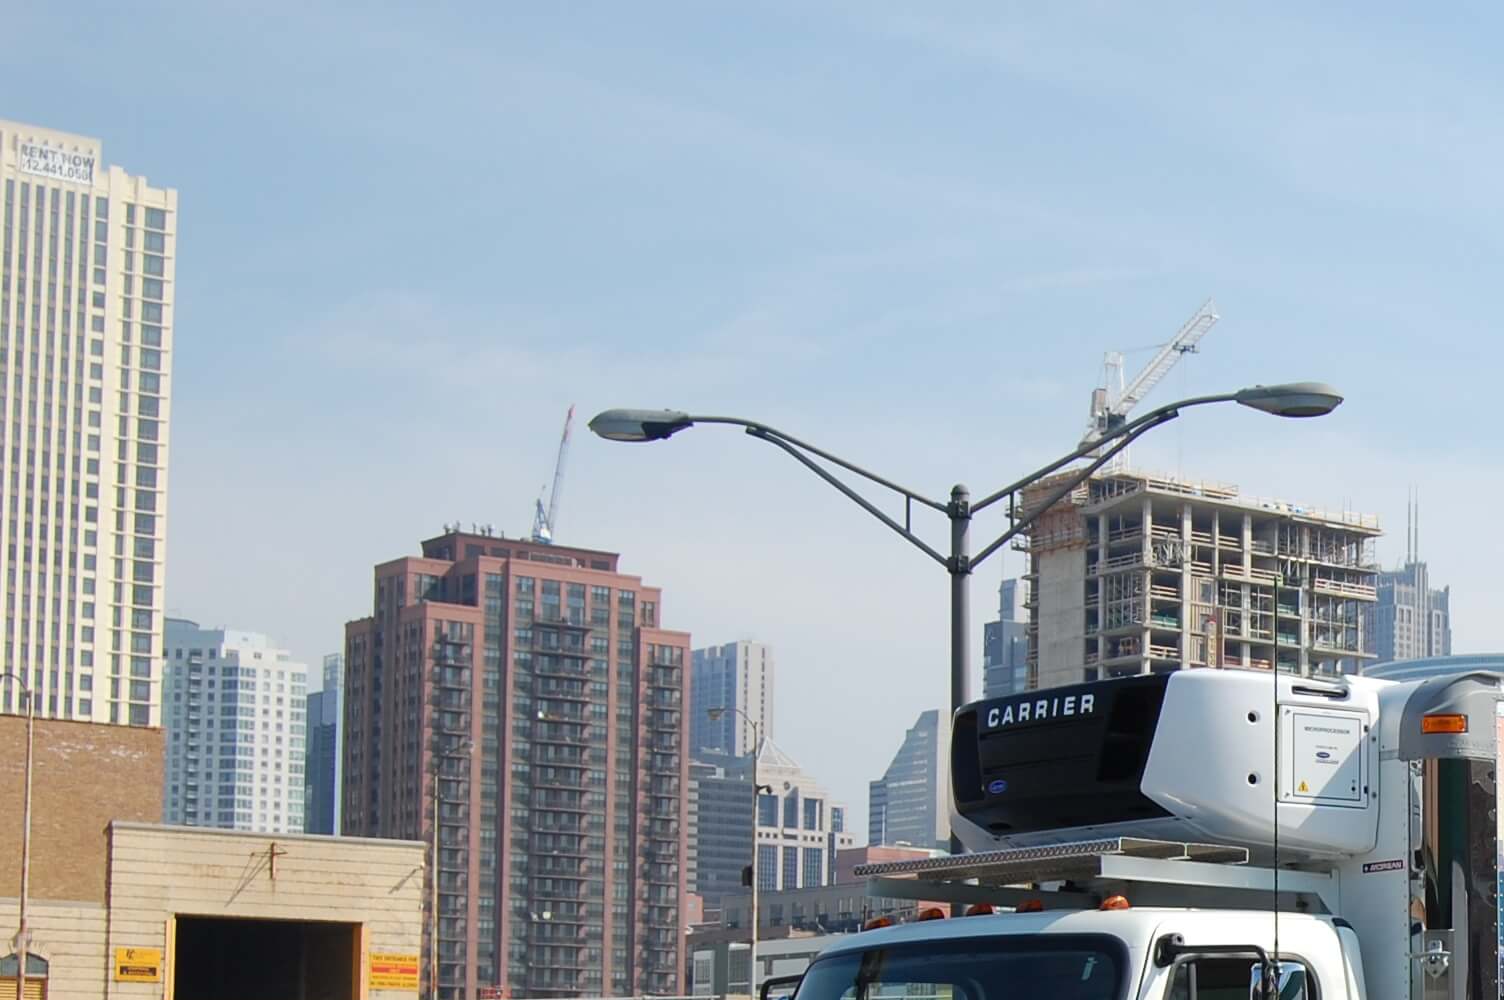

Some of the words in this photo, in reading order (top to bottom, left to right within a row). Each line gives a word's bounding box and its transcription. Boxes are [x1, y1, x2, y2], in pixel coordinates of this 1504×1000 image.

[21, 144, 57, 161] RENT
[61, 152, 95, 169] NOW
[987, 694, 1095, 728] CARRIER
